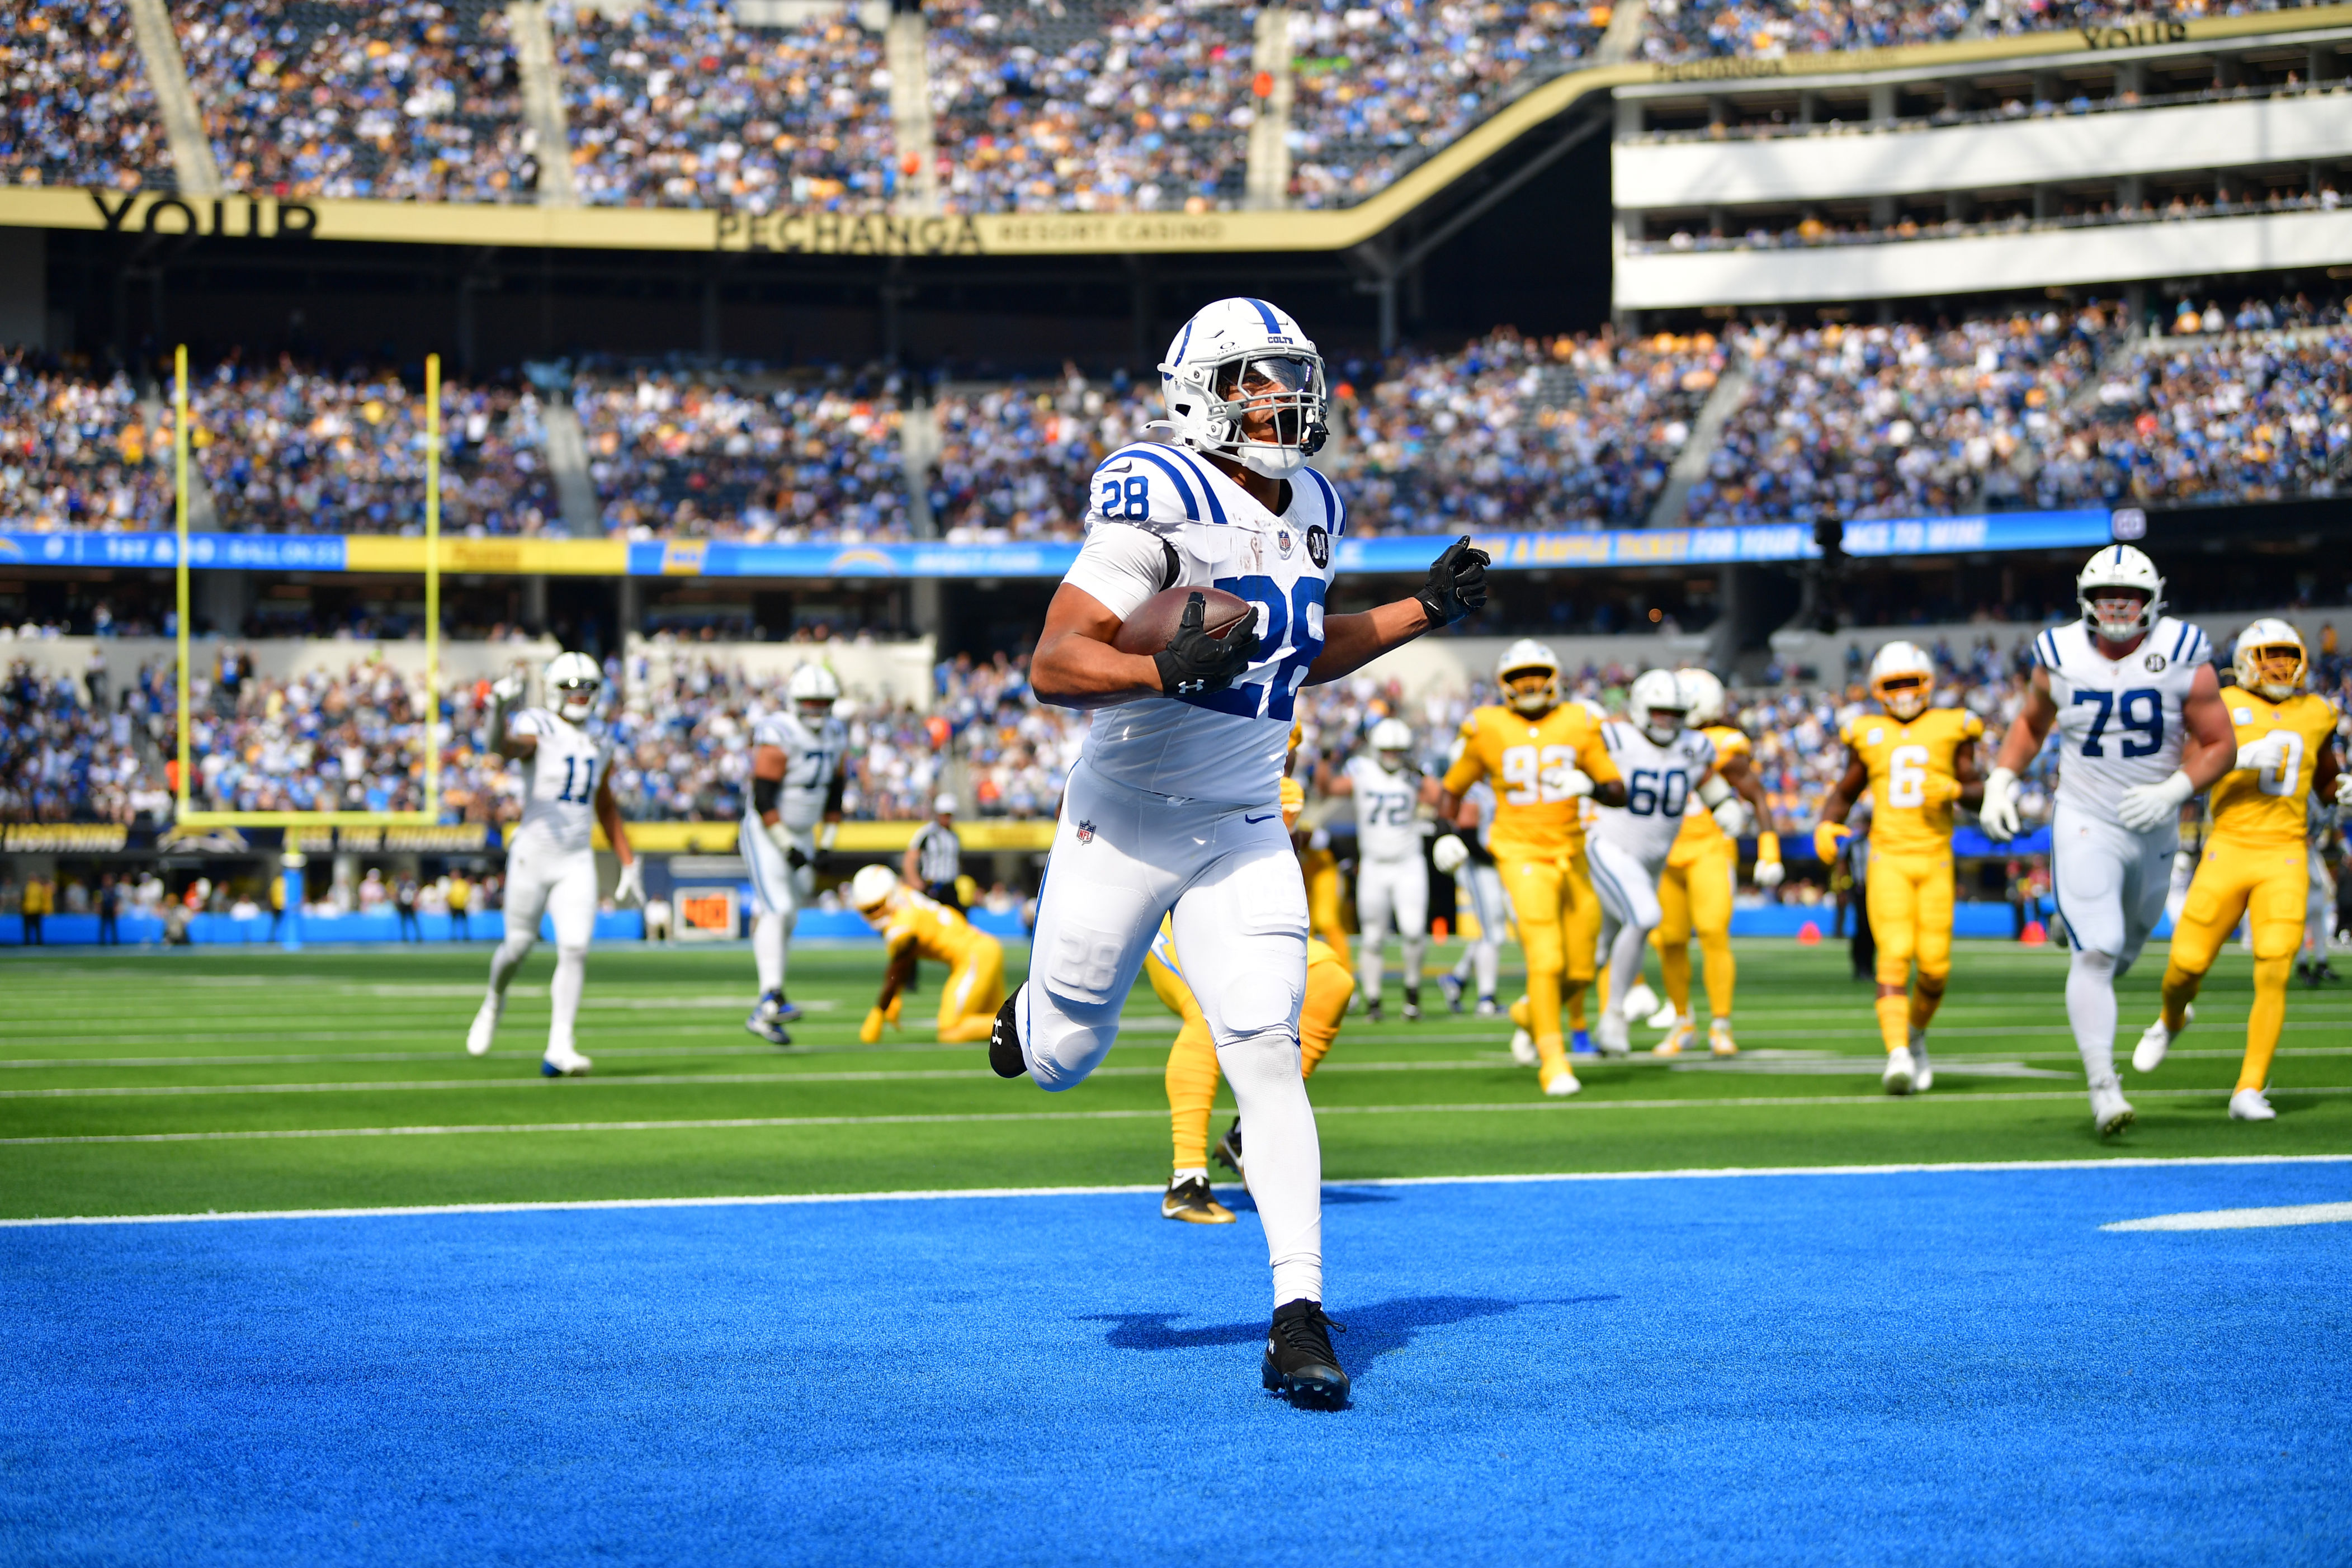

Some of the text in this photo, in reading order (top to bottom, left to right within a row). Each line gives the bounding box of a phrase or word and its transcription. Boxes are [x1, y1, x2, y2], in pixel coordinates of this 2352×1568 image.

[716, 212, 983, 256] PECHANGA
[1116, 218, 1225, 242] CASINO
[1267, 336, 1293, 345] COLTS
[1101, 475, 1149, 521] 28
[1280, 539, 1291, 549] NFL
[2072, 688, 2164, 758] 79
[556, 755, 596, 804] 11
[1628, 769, 1689, 817] 60
[1889, 744, 1929, 809] 6
[1366, 790, 1413, 826] 72
[4, 822, 128, 853] LIGHTNING
[1078, 829, 1090, 840] NFL
